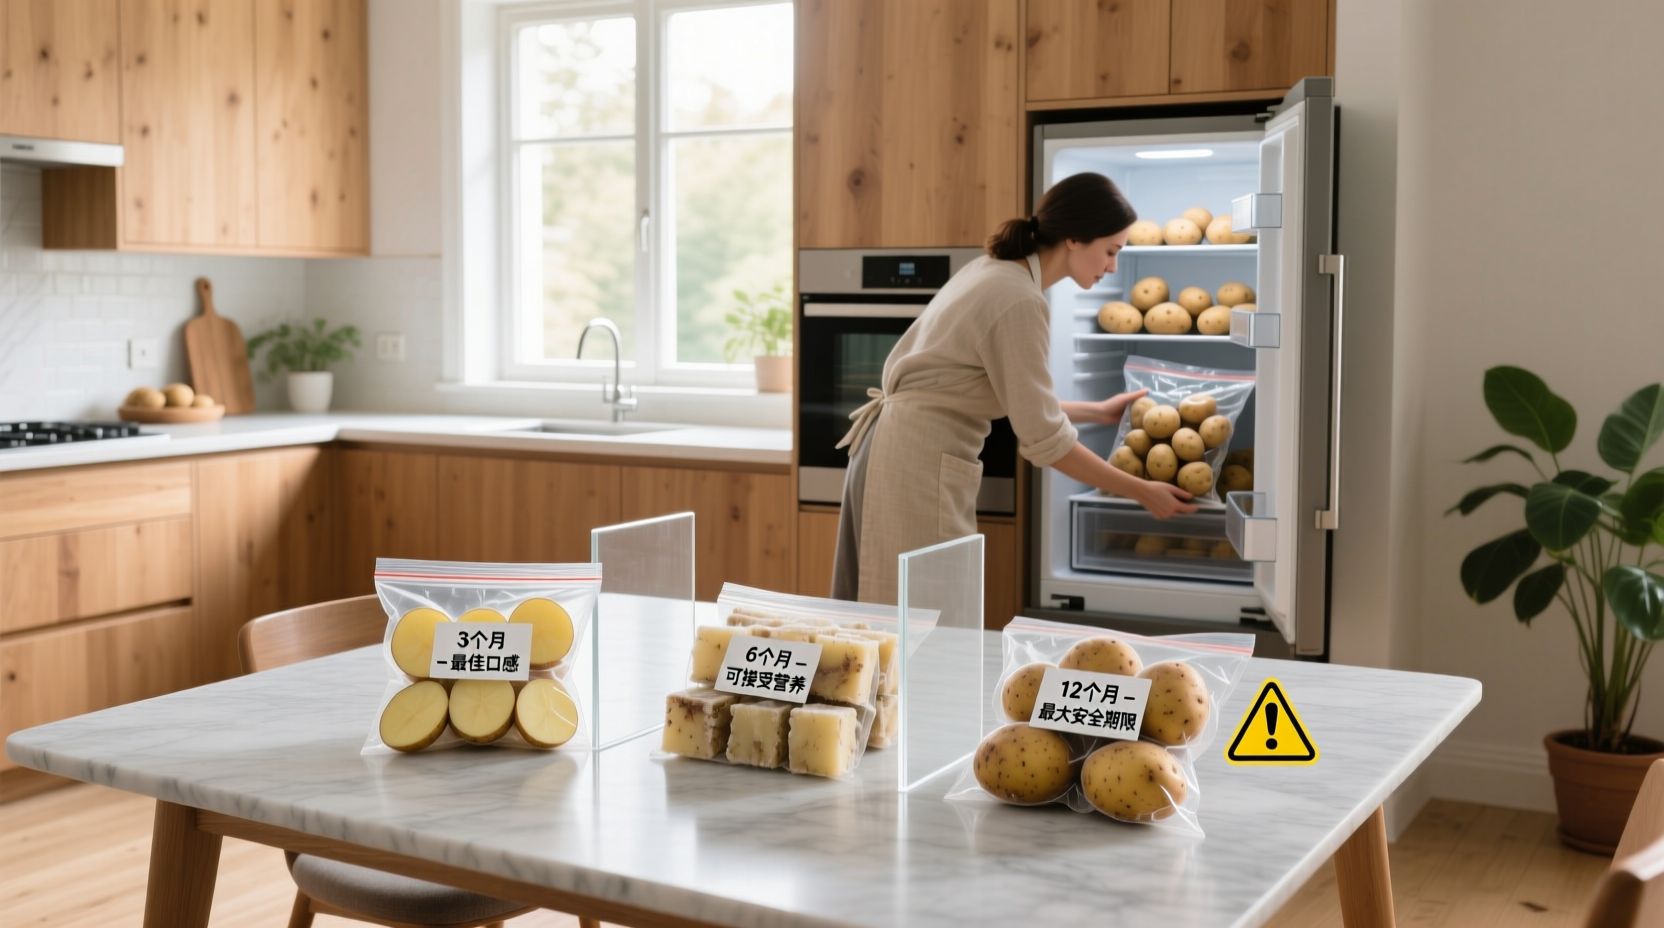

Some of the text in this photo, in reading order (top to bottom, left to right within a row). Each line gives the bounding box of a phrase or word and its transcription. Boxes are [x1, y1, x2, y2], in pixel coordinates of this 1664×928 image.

[457, 630, 505, 650] 3个月
[1038, 702, 1137, 732] 最大安全期限
